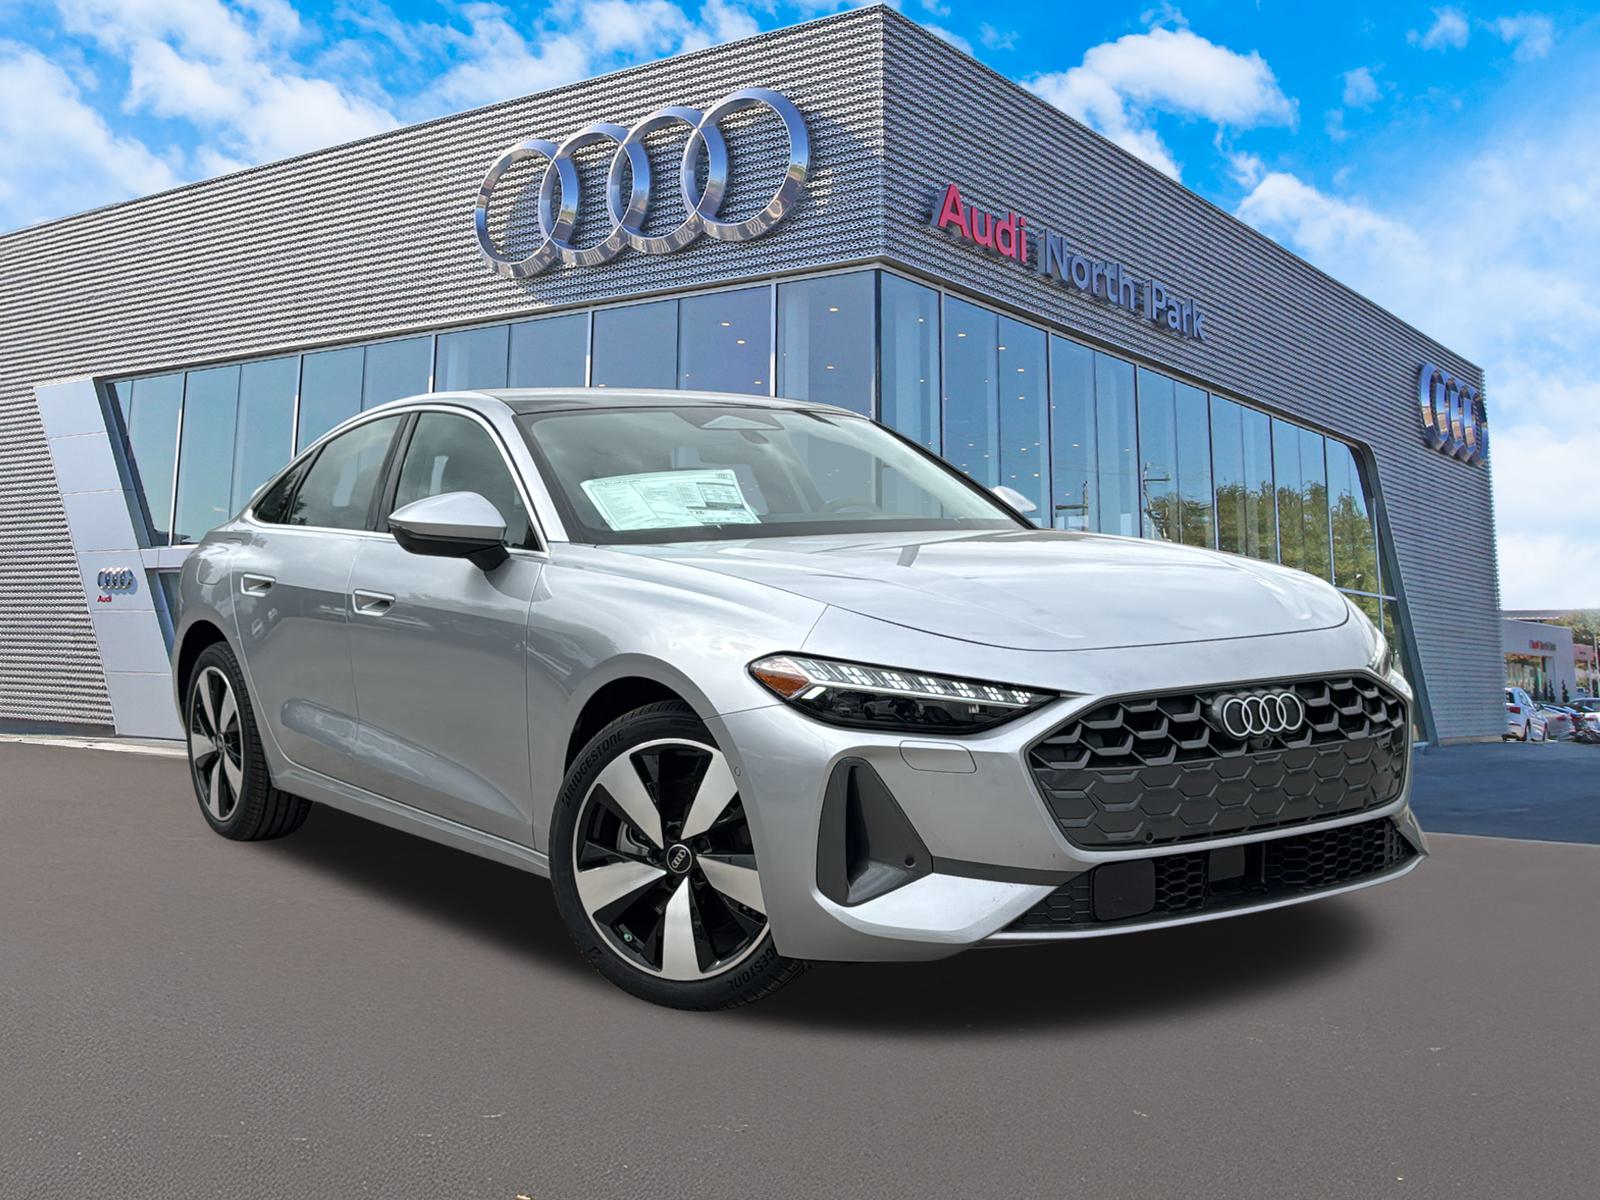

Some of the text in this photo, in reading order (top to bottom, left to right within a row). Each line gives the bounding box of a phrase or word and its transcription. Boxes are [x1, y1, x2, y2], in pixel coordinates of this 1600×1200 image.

[931, 183, 1207, 341] Audi North Park
[97, 595, 113, 603] Audi
[561, 730, 625, 807] BRIDGESTONE
[728, 947, 777, 991] GESTONE
